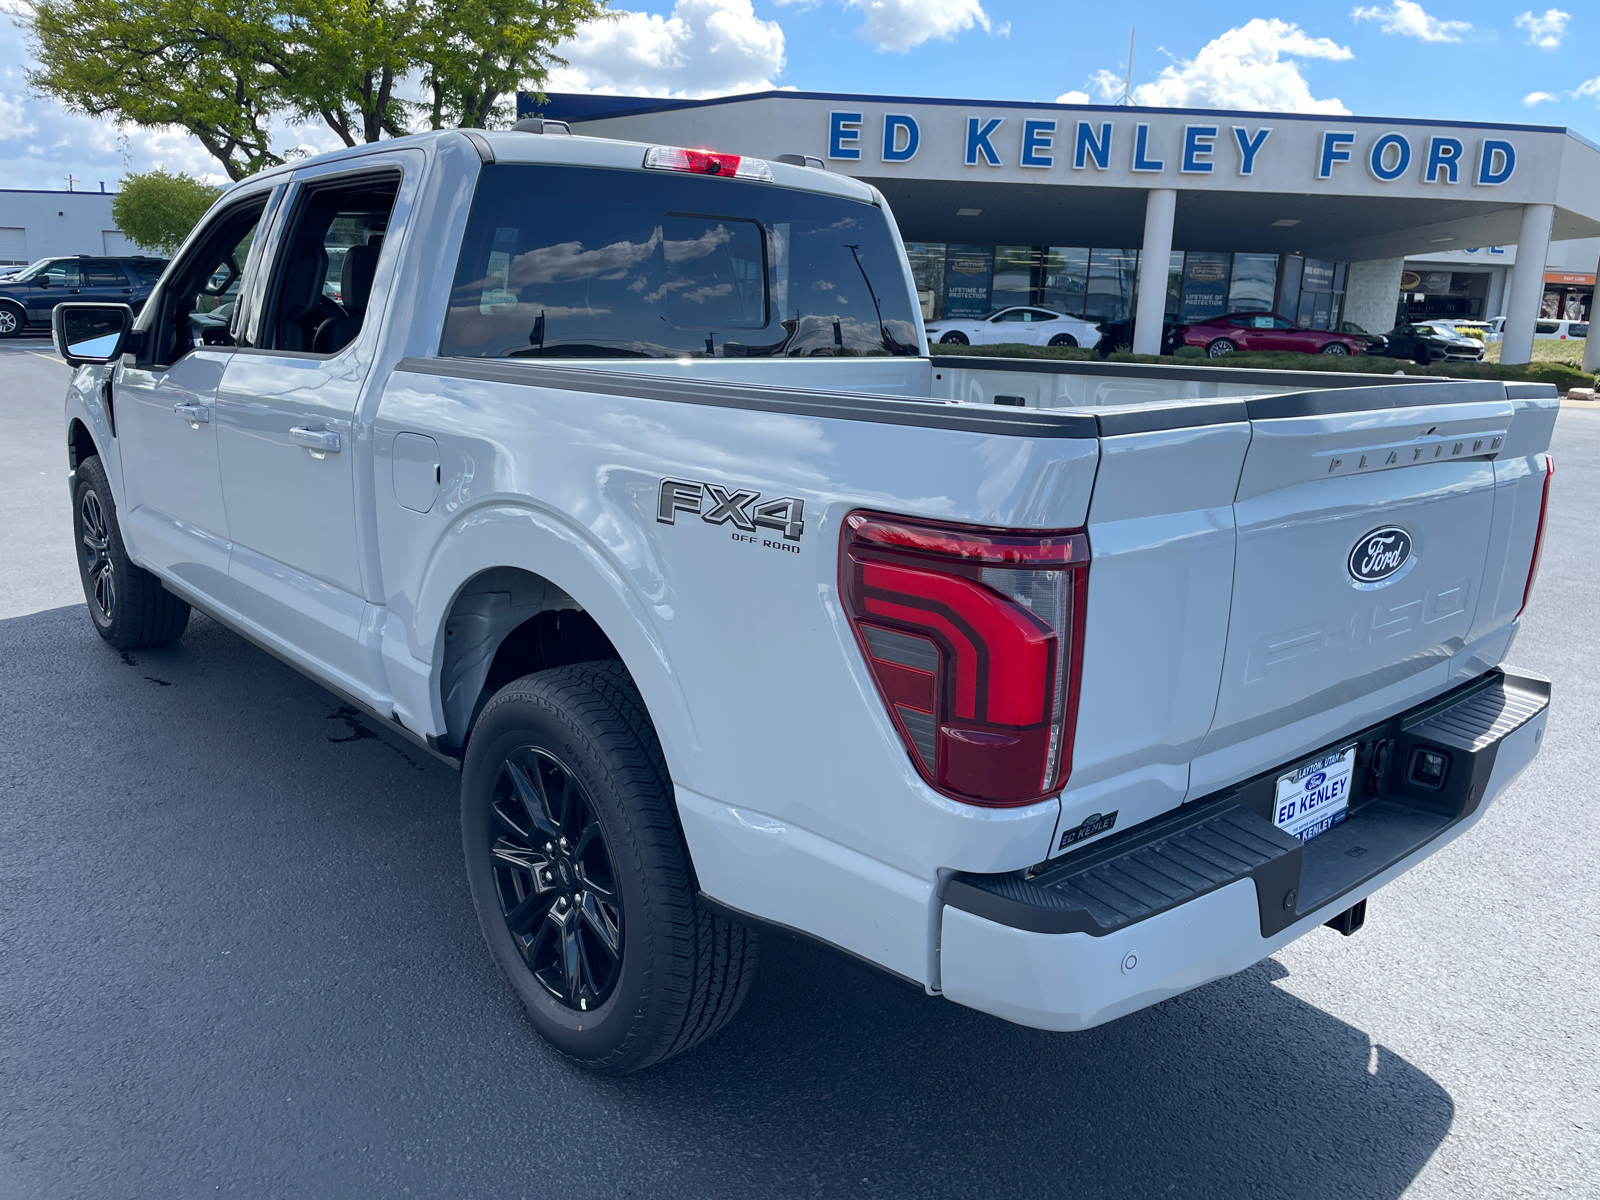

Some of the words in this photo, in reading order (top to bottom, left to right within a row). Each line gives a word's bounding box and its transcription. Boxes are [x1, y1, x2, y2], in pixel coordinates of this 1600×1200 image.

[828, 110, 920, 163] ED
[964, 116, 1273, 176] KENLEY
[1315, 130, 1517, 186] FORD
[1328, 436, 1503, 473] PLATINUM
[656, 476, 806, 542] FX4
[731, 532, 758, 544] OFF
[763, 539, 801, 554] ROAD
[1360, 534, 1405, 575] Ford
[1244, 577, 1471, 685] F-150
[1324, 752, 1341, 767] UTAH
[1278, 801, 1296, 824] ED
[1300, 776, 1348, 814] KENLEY
[1061, 832, 1076, 846] ED
[1077, 815, 1117, 839] KENLEY
[1302, 815, 1334, 842] KENLEY
